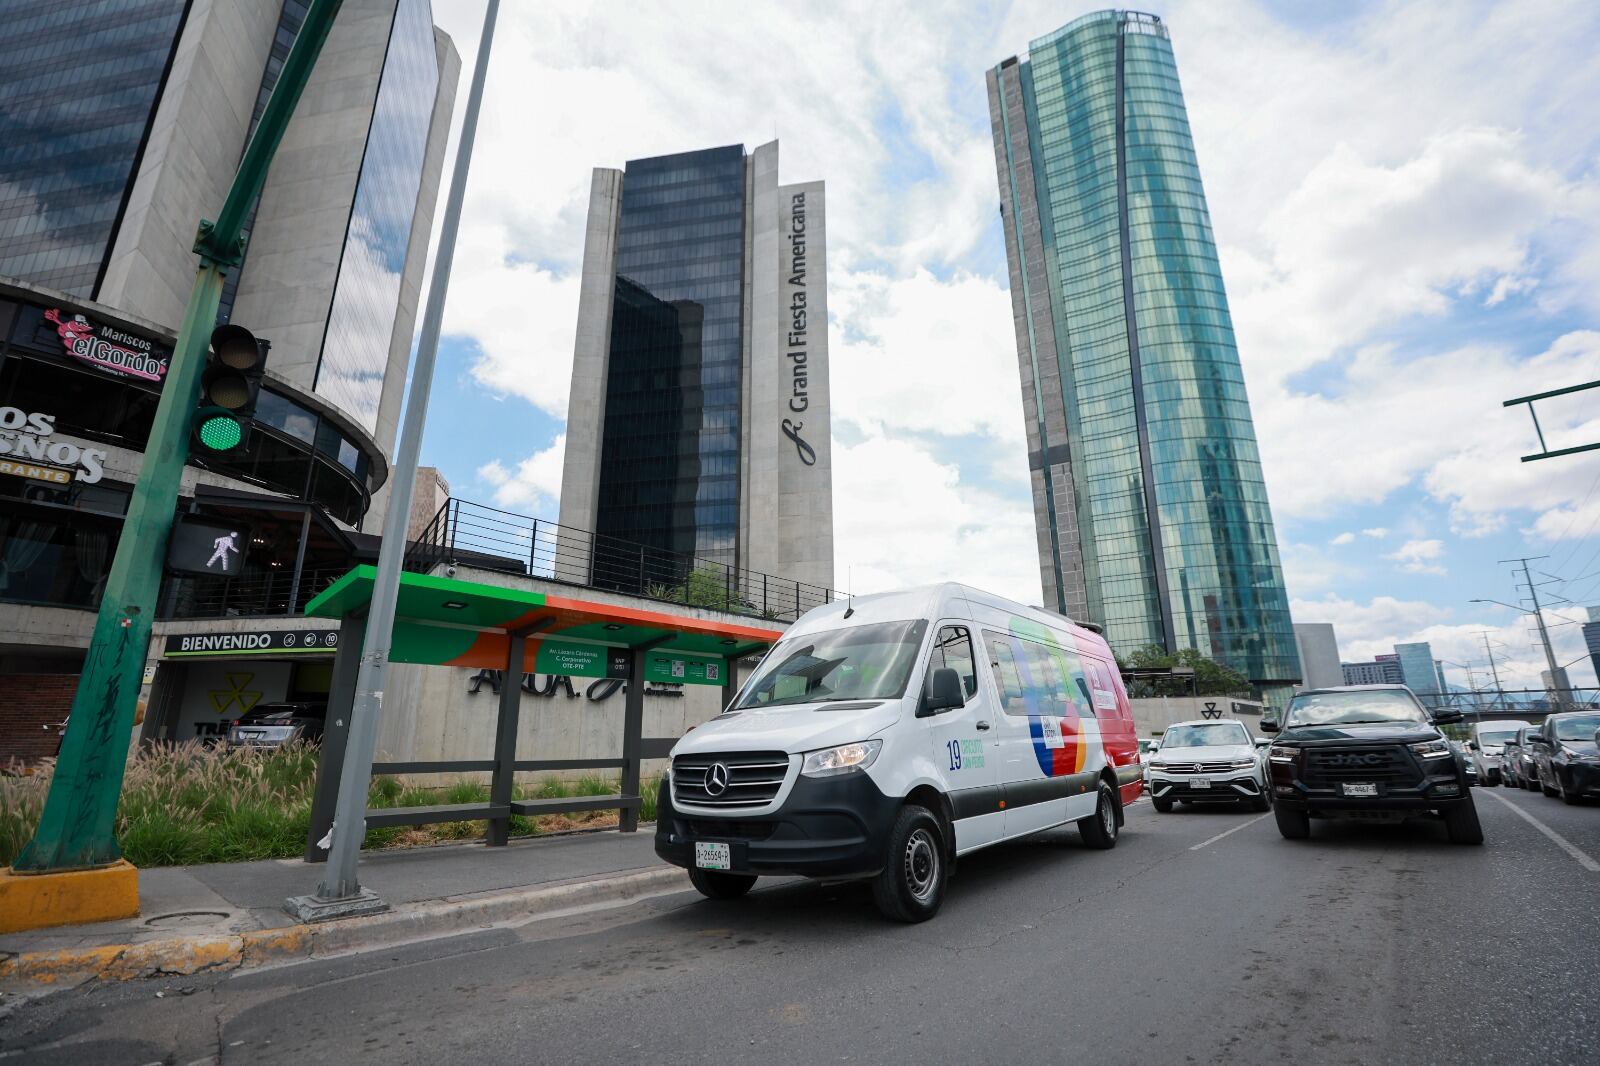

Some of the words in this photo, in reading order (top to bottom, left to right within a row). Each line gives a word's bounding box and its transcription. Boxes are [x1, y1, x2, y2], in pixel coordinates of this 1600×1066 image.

[788, 192, 806, 286] Americana
[788, 292, 807, 347] Fiesta
[101, 326, 152, 351] Mariscos
[787, 352, 808, 412] Grand
[1, 462, 66, 483] RANTE
[181, 633, 272, 651] BIENVENIDO
[946, 739, 962, 771] 19
